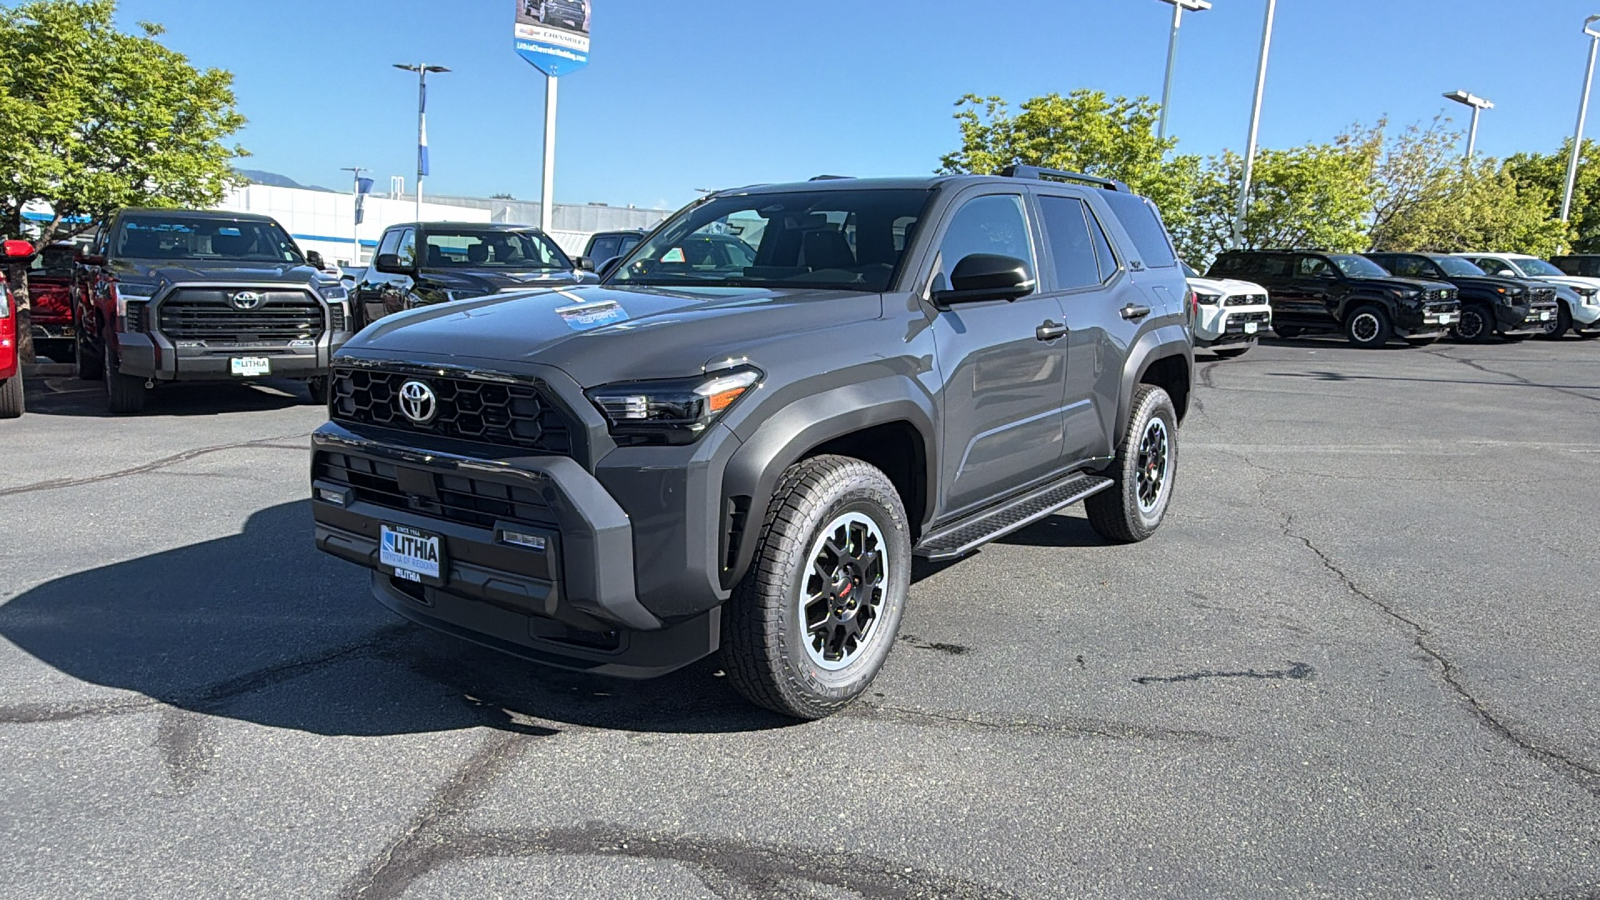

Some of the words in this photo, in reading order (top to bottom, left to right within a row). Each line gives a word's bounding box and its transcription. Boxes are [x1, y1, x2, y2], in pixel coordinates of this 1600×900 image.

[544, 32, 585, 45] CHEVROLET
[241, 360, 267, 368] LITHIA
[394, 534, 438, 563] LITHIA
[383, 551, 402, 562] TOYOTA
[412, 557, 439, 572] REDDING
[401, 569, 421, 582] LITHIA
